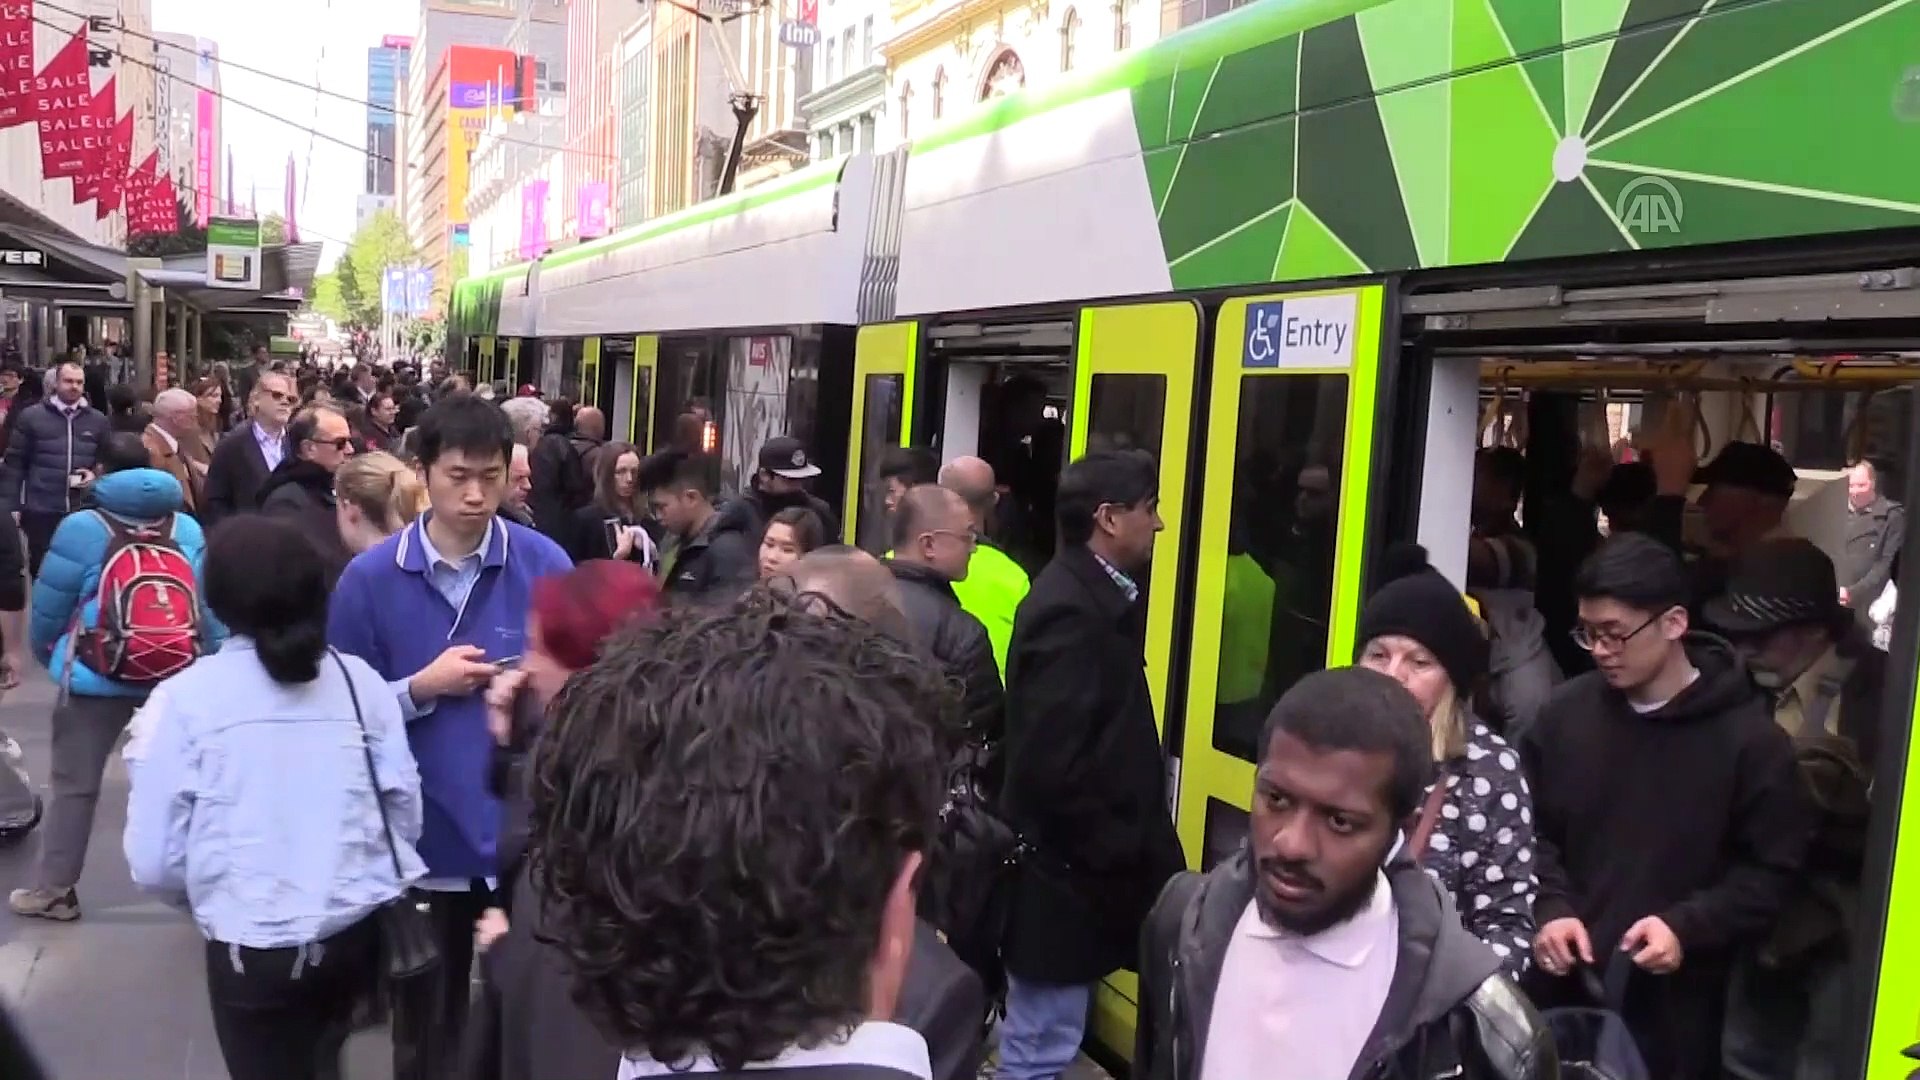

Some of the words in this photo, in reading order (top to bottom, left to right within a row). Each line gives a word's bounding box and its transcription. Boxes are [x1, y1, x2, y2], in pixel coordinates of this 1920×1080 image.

[790, 23, 815, 44] Inn
[35, 72, 88, 91] SALE
[37, 93, 90, 111] SALE
[40, 115, 93, 133] SALE
[43, 136, 97, 155] SALE
[1285, 317, 1347, 354] Entry
